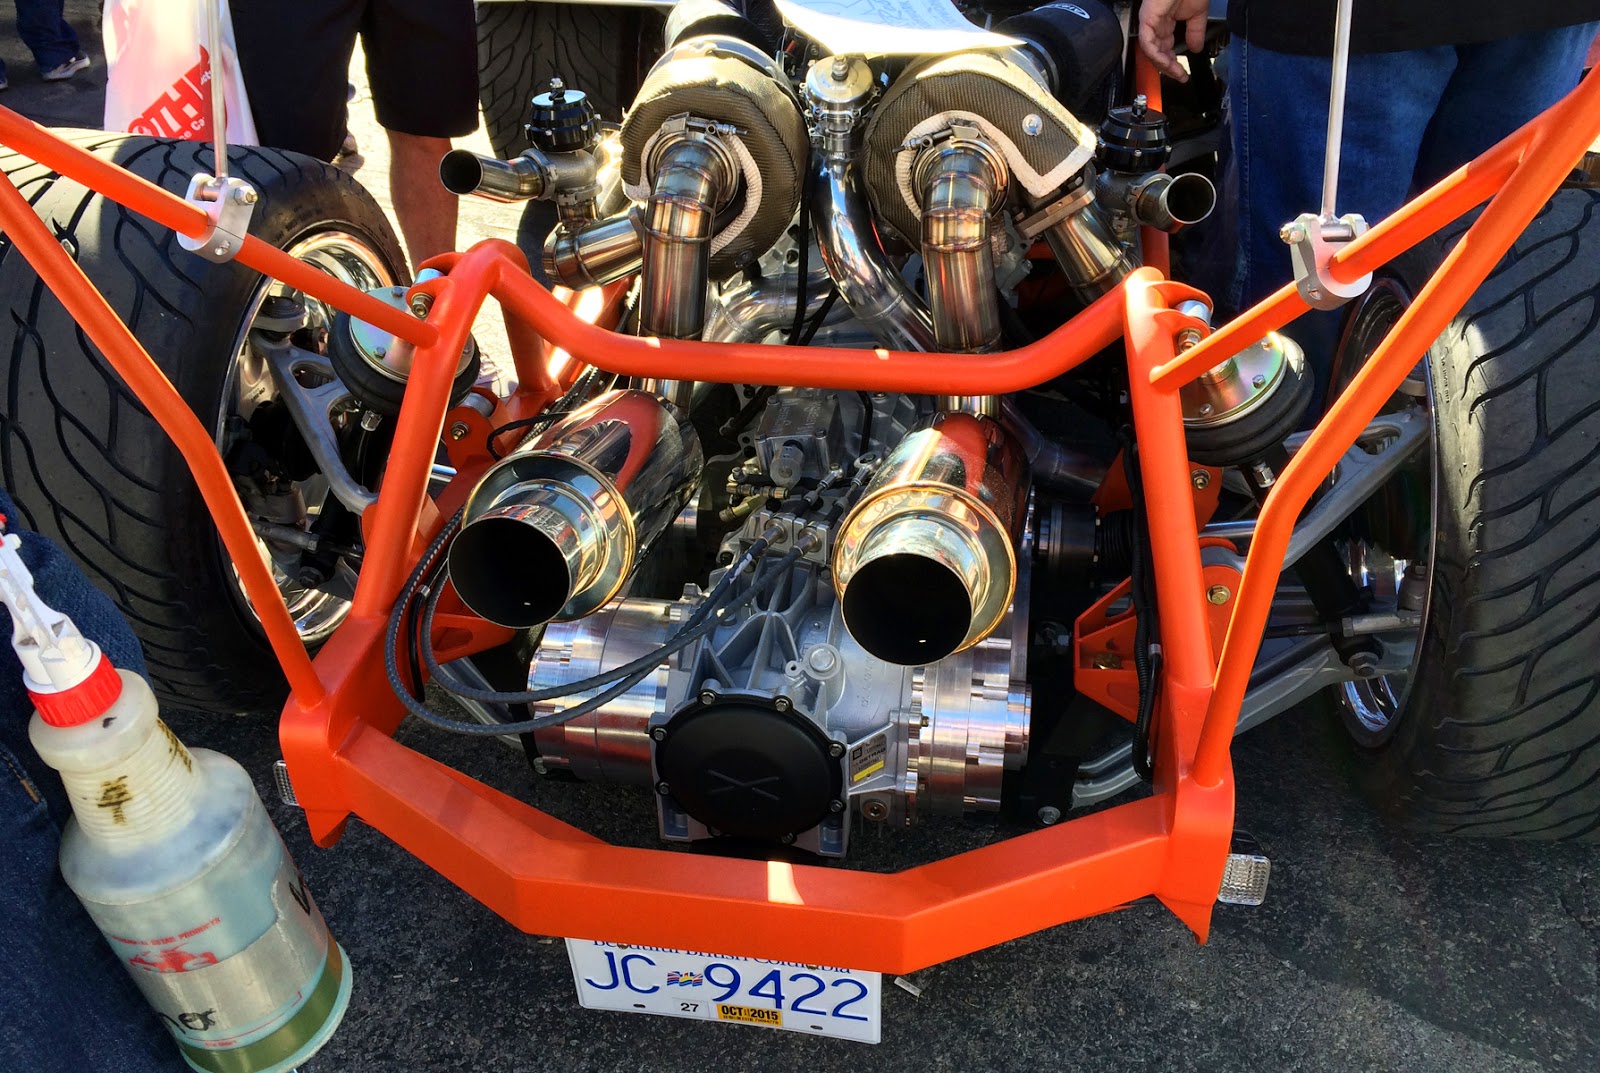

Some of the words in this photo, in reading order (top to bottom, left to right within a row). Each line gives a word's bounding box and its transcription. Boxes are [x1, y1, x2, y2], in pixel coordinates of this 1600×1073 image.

[584, 950, 660, 994] JC
[704, 963, 869, 1021] 9422
[680, 1002, 699, 1013] 27
[721, 1005, 743, 1017] OCT
[750, 1008, 779, 1021] 2015
